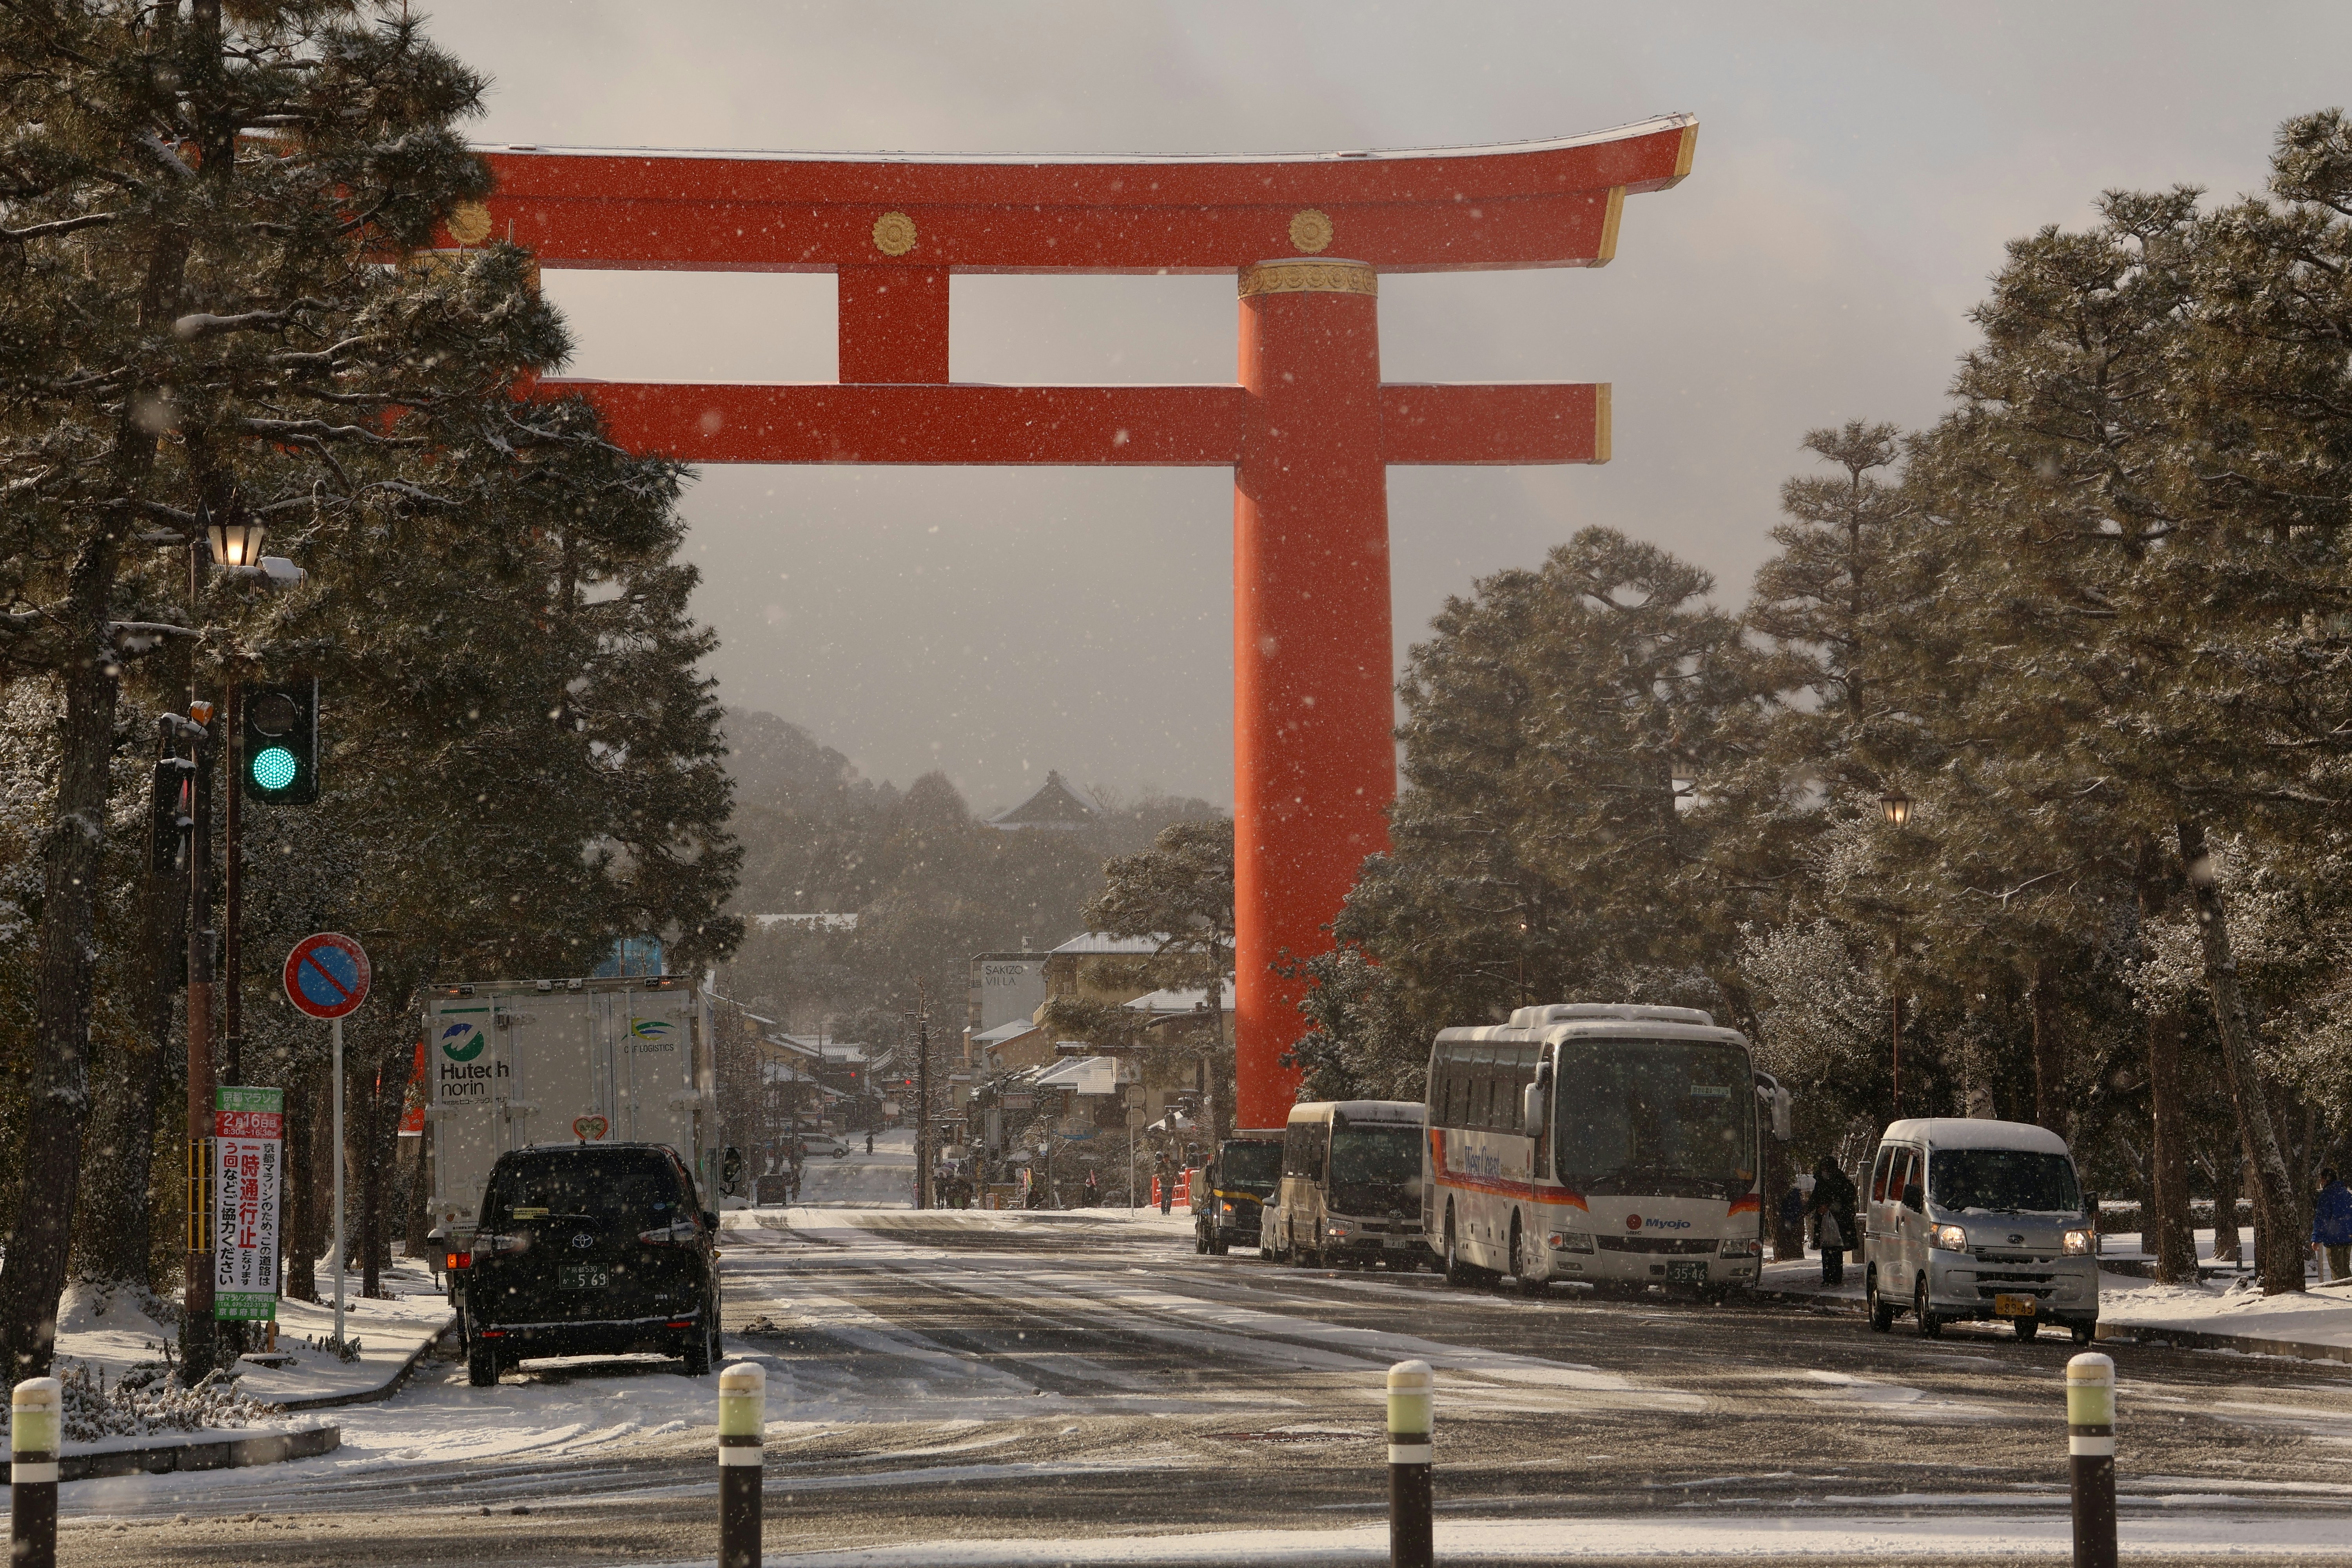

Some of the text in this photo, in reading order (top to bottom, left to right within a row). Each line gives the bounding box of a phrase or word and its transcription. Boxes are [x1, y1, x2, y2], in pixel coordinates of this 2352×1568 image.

[985, 965, 1023, 974] SAKIZO
[985, 977, 1016, 985] VILLA
[640, 1044, 674, 1053] LOGISTICS
[442, 1080, 484, 1096] norin
[223, 1091, 280, 1103] 京都マラソン
[1465, 1146, 1480, 1181] West
[1481, 1145, 1500, 1184] Coast
[220, 1142, 238, 1285] う回などご協力ください
[258, 1143, 275, 1286] 京都マラソンのため、この道路は
[1645, 1218, 1691, 1229] Myojo
[1675, 1268, 1704, 1280] 35-46
[215, 1294, 275, 1302] 京都マラソン実行委員会
[219, 1308, 268, 1316] 京都府警察
